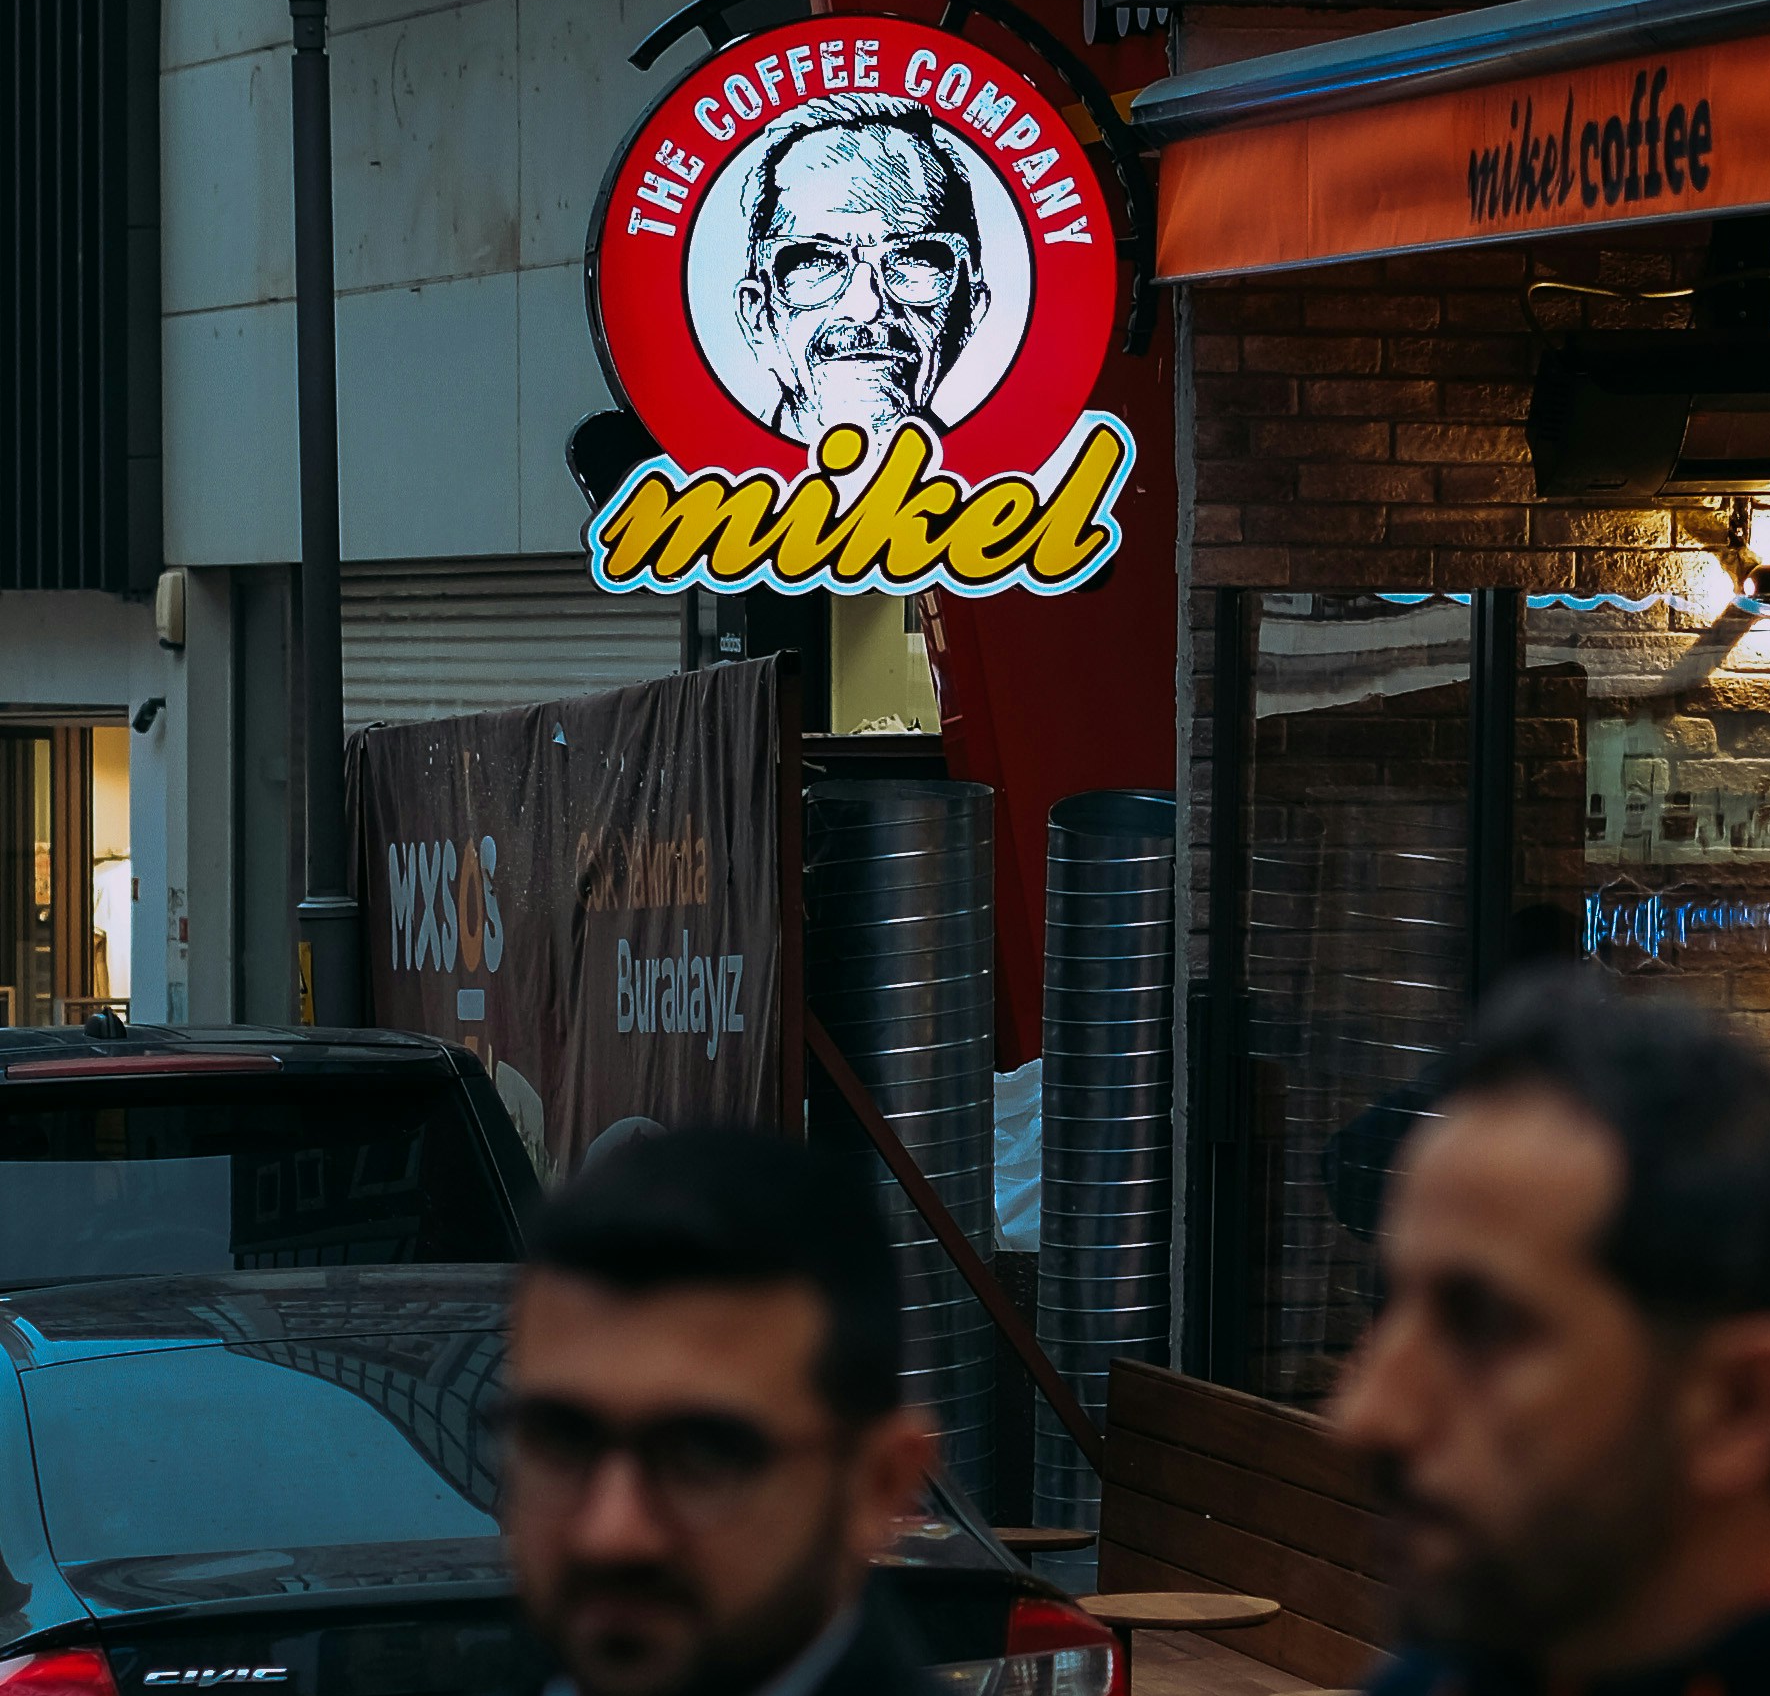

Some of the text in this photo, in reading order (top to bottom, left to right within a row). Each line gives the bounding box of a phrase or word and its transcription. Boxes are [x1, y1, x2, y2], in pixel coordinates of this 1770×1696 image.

[628, 39, 1093, 247] THE COFFEE COMPANY
[1467, 65, 1712, 224] mikel coffee
[600, 420, 1126, 581] mikel
[143, 1668, 288, 1687] CIVIC
